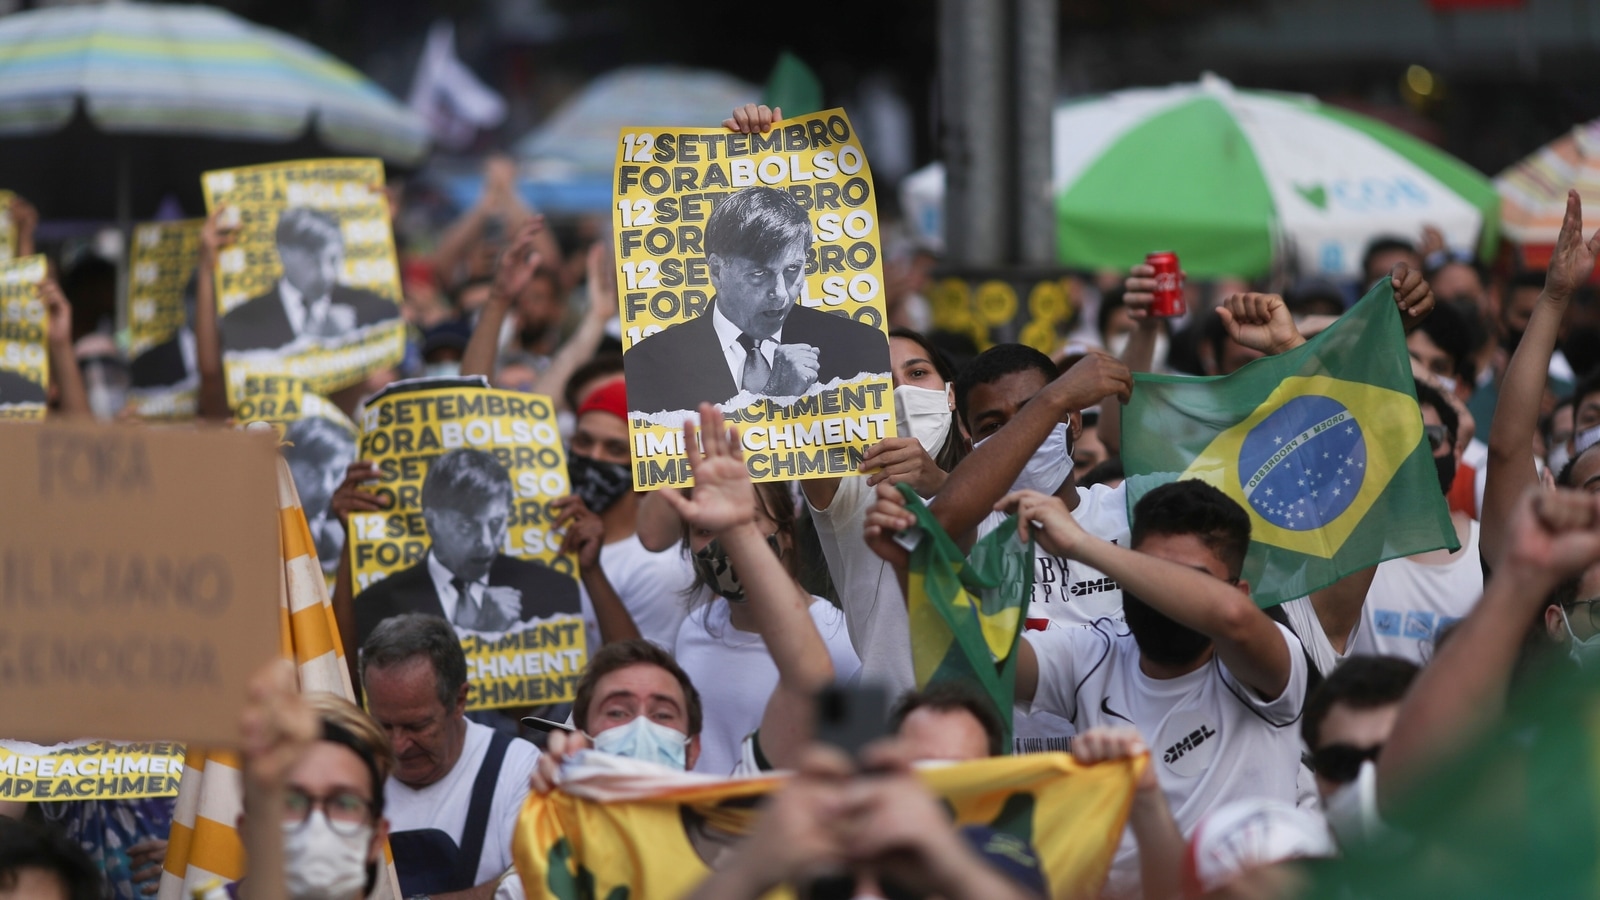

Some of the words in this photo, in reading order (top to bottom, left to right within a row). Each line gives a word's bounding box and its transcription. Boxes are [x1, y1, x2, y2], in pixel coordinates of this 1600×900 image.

[2, 549, 235, 619] ILICIANO
[466, 649, 582, 680] CHMENT
[469, 673, 581, 706] CHMENT
